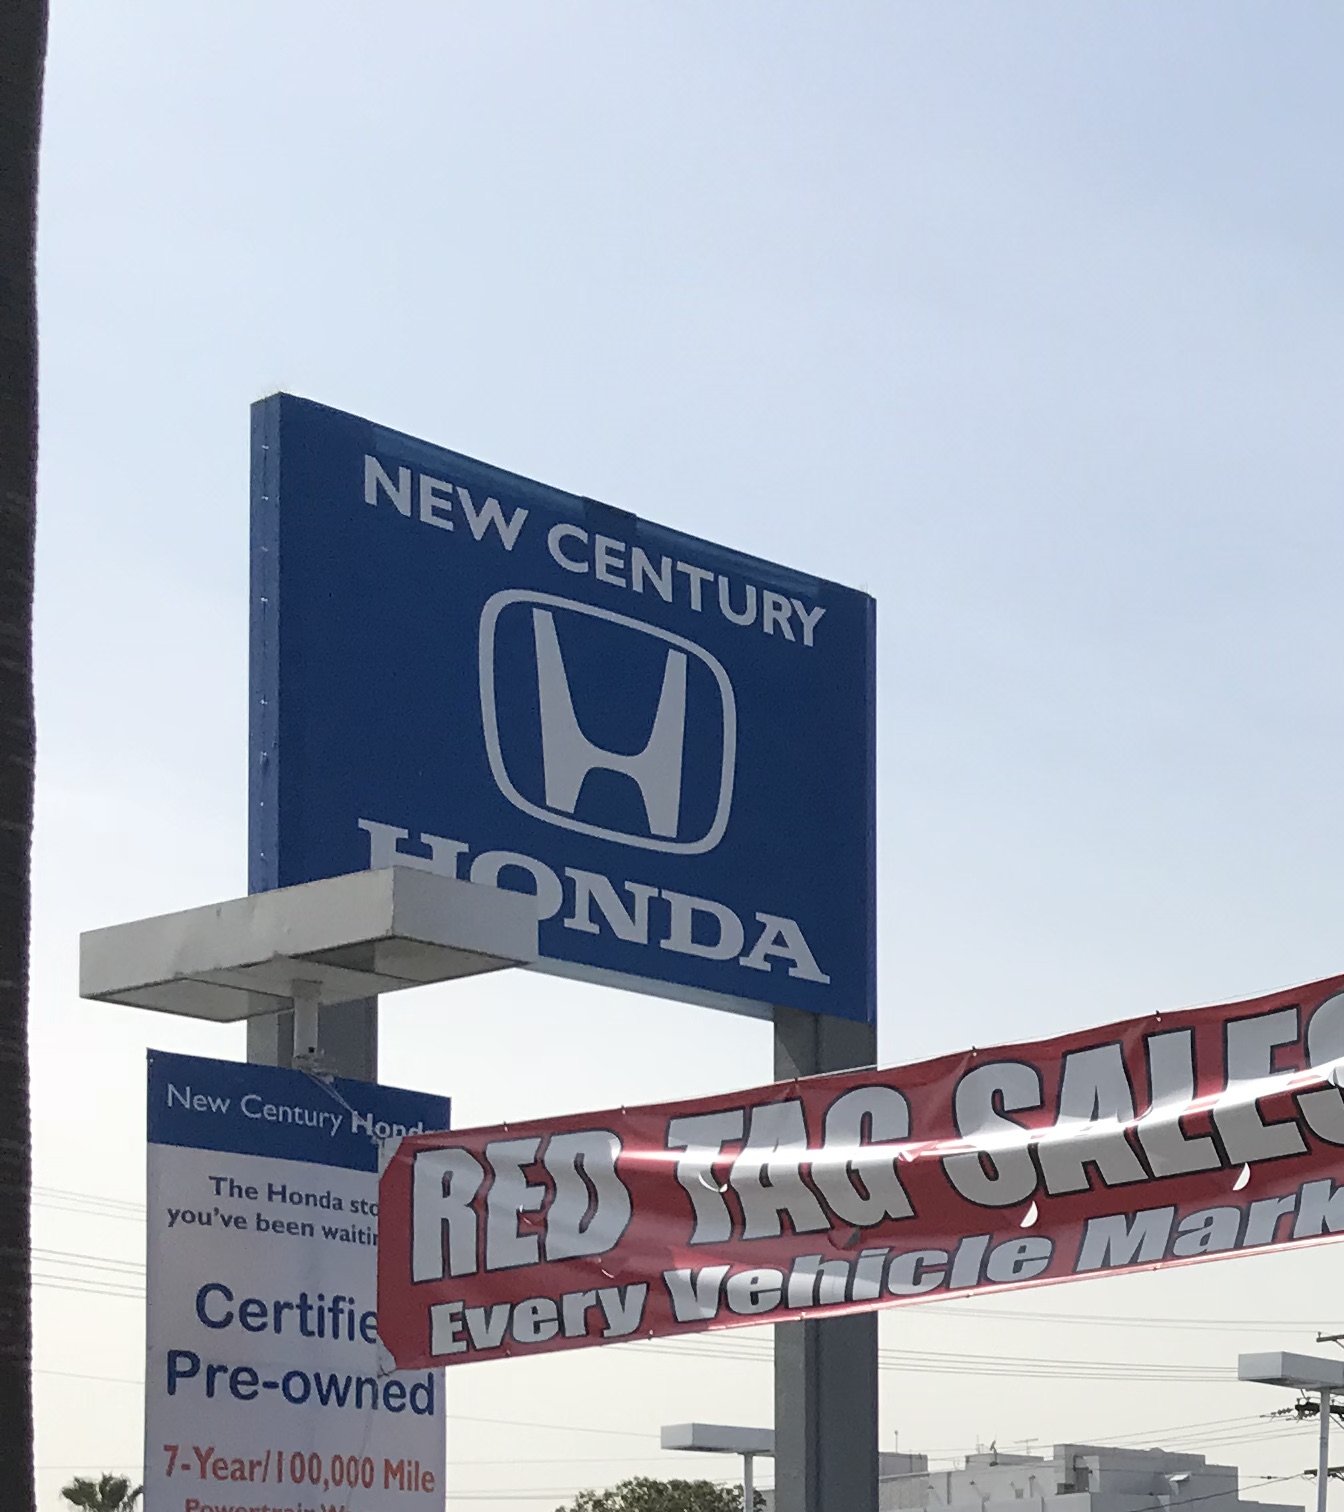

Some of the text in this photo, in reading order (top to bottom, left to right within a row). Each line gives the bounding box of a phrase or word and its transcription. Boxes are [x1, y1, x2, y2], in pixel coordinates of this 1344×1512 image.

[364, 455, 826, 646] NEW CENTURY
[357, 817, 830, 985] HONDA
[167, 1083, 450, 1139] New Century Hond
[209, 1175, 258, 1200] The
[267, 1183, 343, 1211] Honda
[411, 1128, 633, 1284] RED
[665, 1084, 915, 1246] TAG
[168, 1207, 248, 1229] you've
[256, 1213, 314, 1237] been
[430, 1281, 648, 1358] Every
[663, 1233, 1054, 1323] Vehicle
[166, 1350, 434, 1416] Pre-owned
[163, 1445, 435, 1493] 7-Year/100,000 Mile
